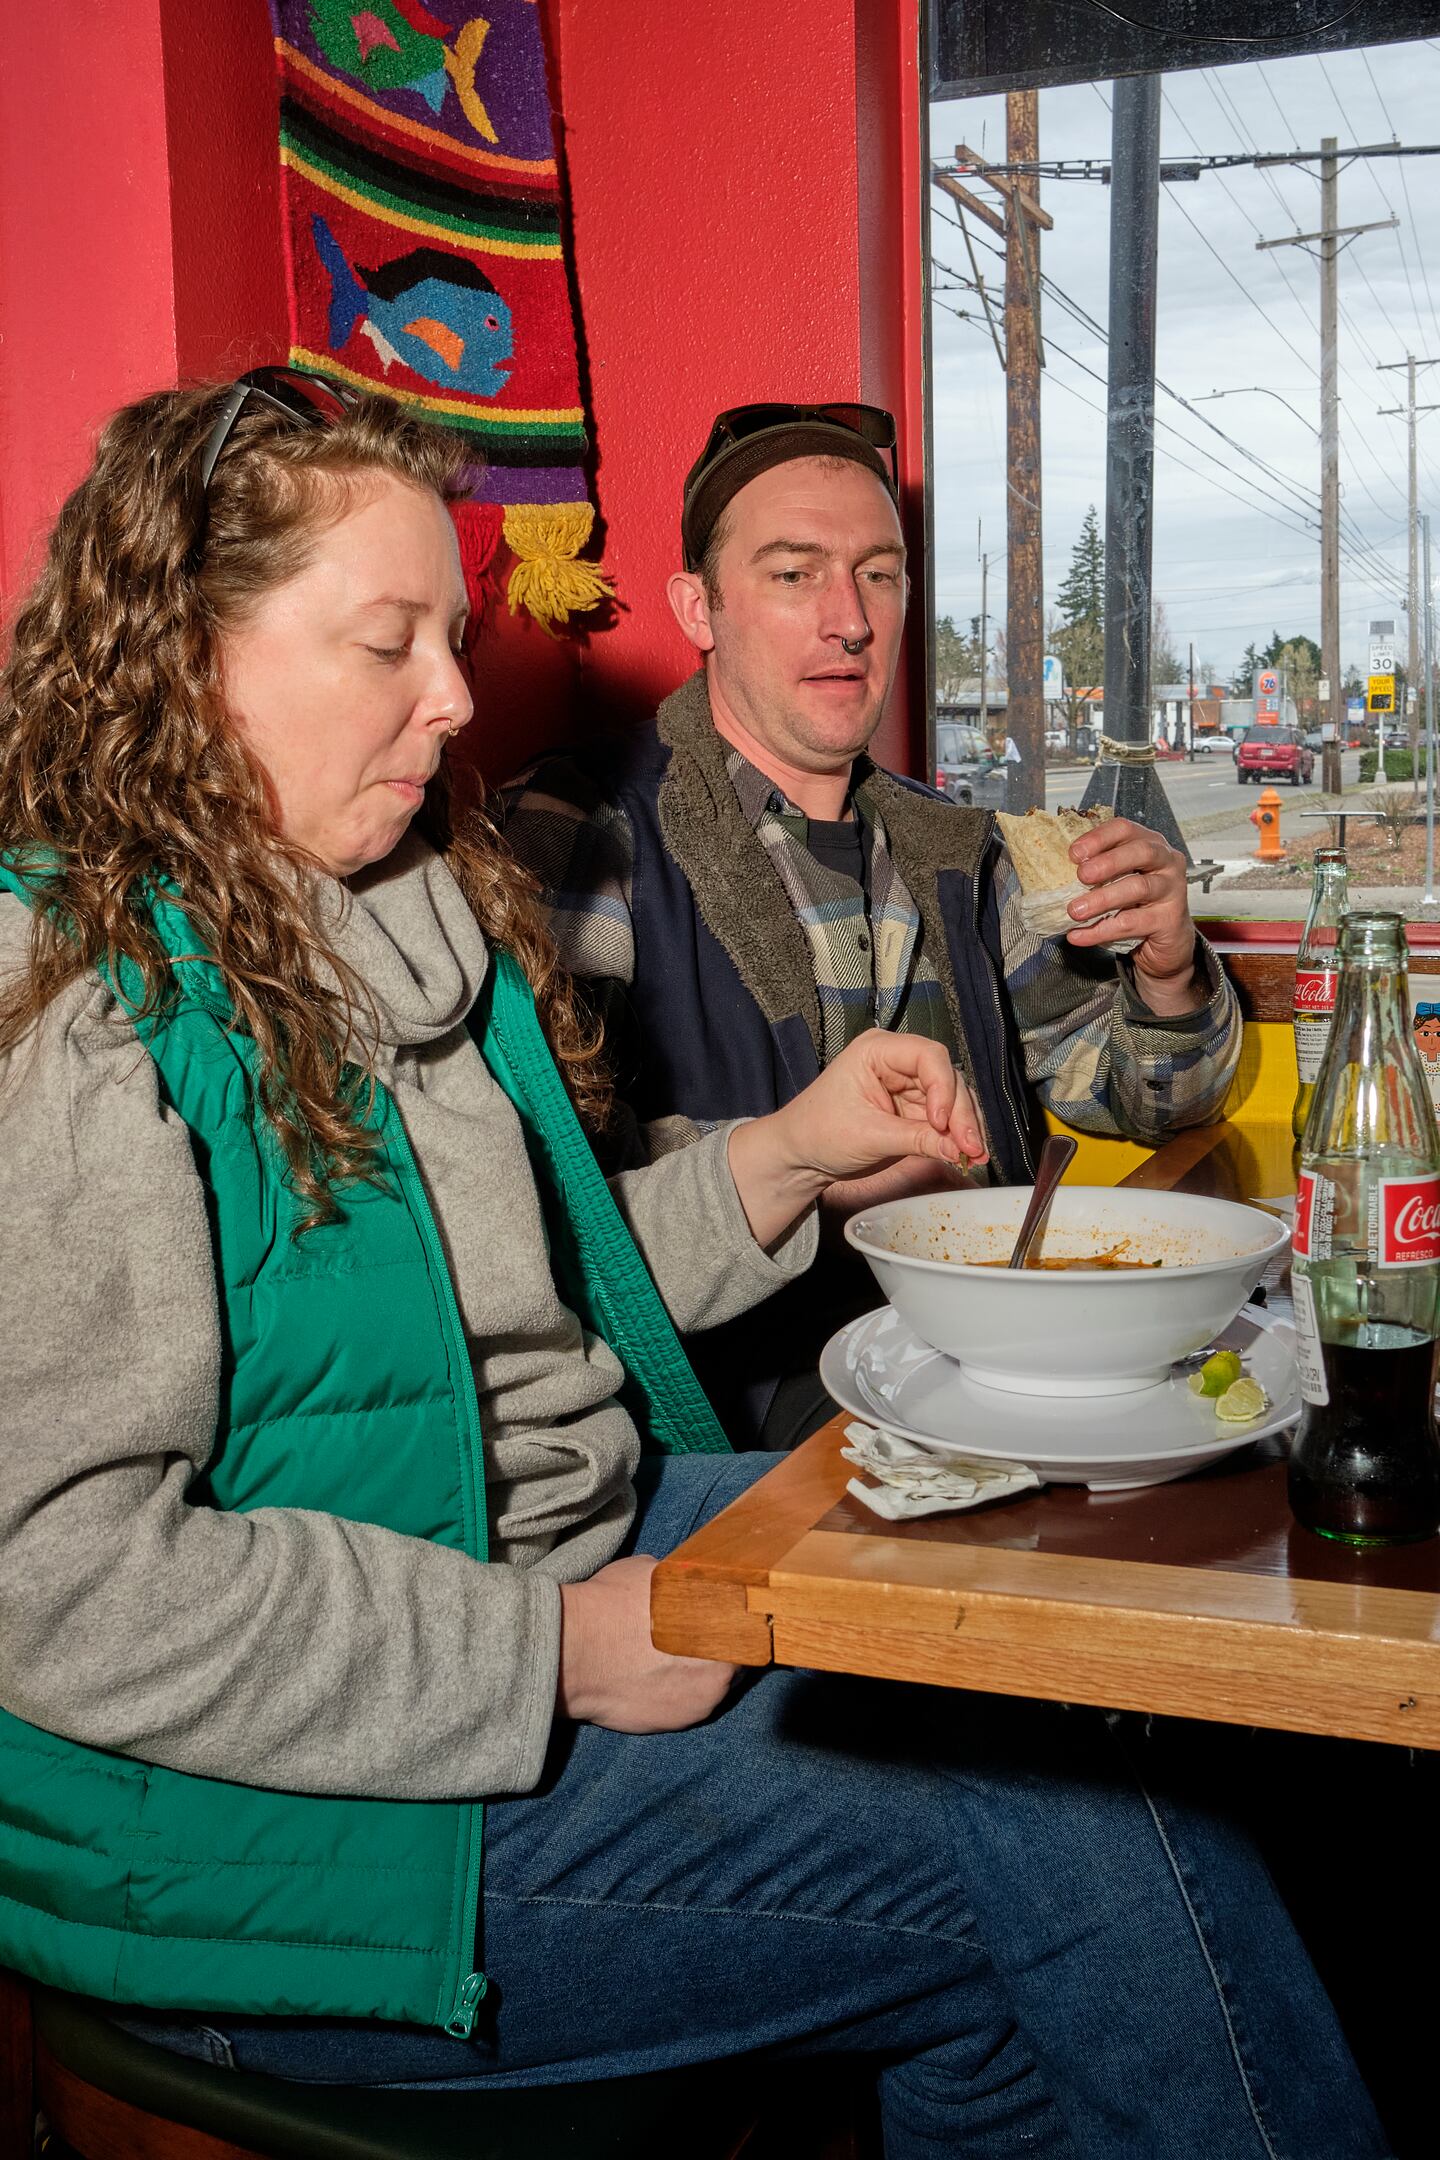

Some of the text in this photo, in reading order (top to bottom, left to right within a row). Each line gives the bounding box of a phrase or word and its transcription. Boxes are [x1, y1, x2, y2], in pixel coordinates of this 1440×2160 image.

[1372, 658, 1392, 670] 30
[1264, 678, 1275, 689] 76
[1367, 1183, 1378, 1262] NO RETORNABLE
[1395, 1249, 1434, 1261] REFRESCO
